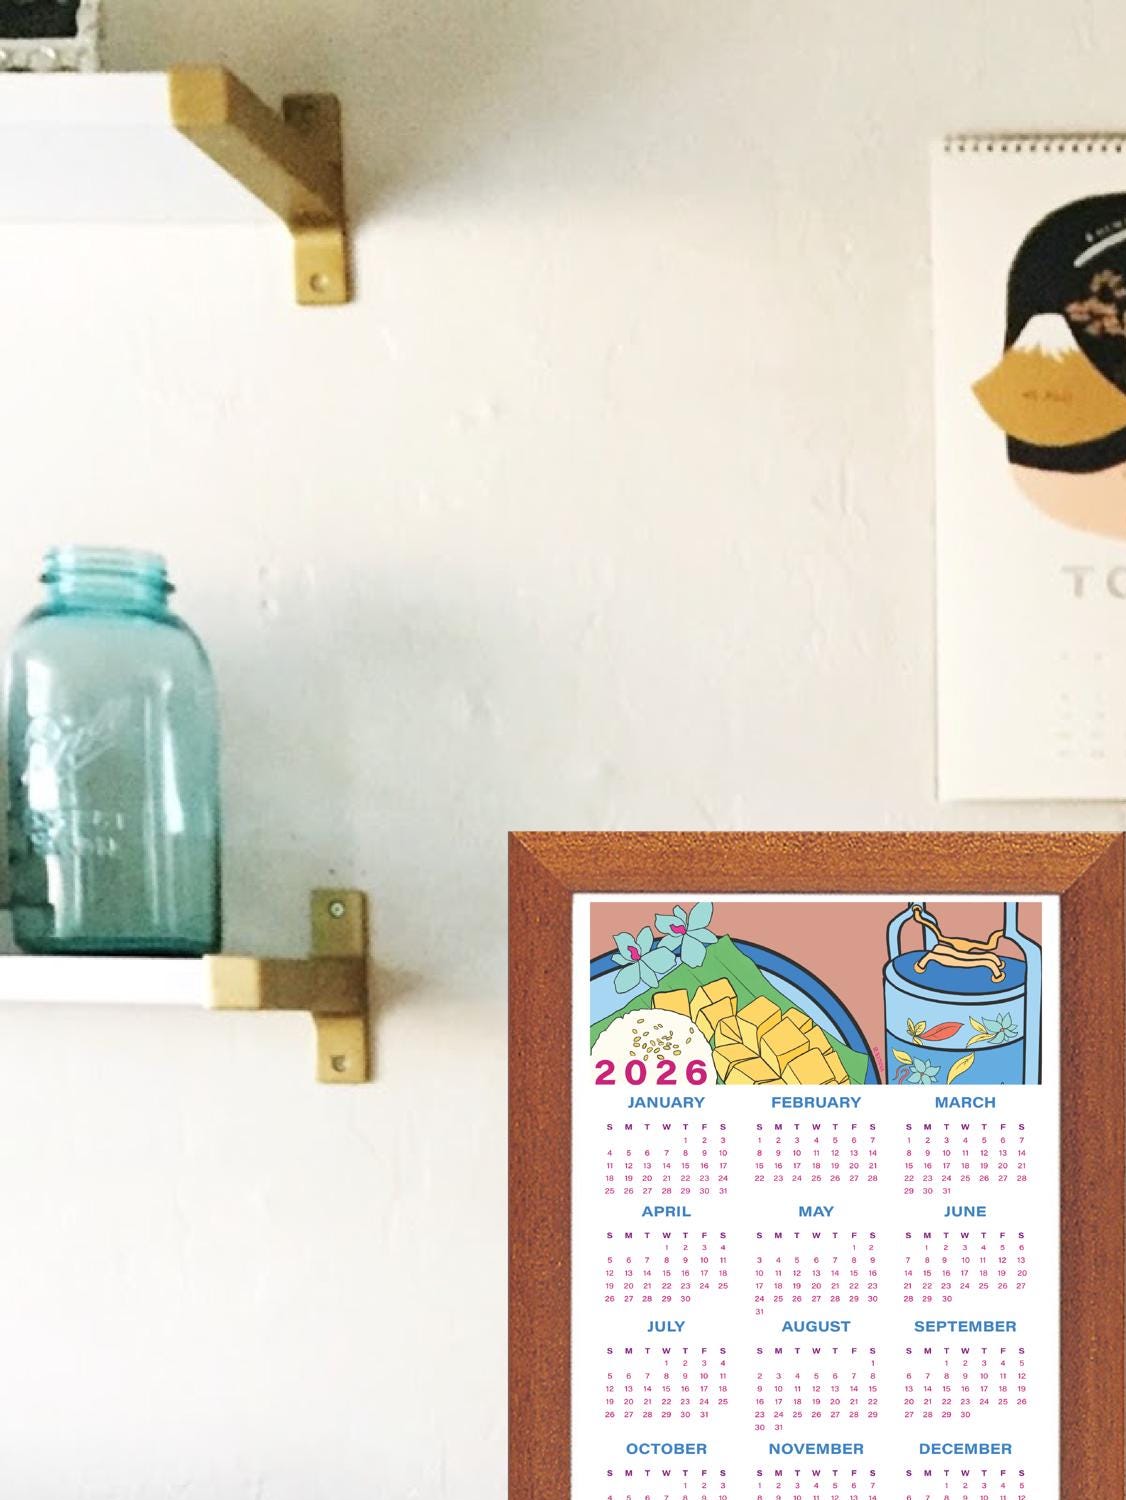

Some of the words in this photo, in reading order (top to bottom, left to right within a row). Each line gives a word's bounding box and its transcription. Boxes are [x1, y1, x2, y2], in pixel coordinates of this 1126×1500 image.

[595, 1059, 707, 1085] 2026
[627, 1096, 706, 1109] JANUARY
[771, 1096, 862, 1109] FEBRUARY
[935, 1096, 996, 1109] MARCH
[606, 1123, 613, 1131] S
[624, 1123, 633, 1131] M
[643, 1123, 651, 1131] T
[662, 1123, 672, 1131] W
[682, 1123, 689, 1131] T
[701, 1123, 708, 1131] F
[719, 1123, 727, 1131] S
[756, 1123, 763, 1131] S
[774, 1123, 783, 1131] M
[793, 1123, 800, 1131] T
[811, 1123, 821, 1131] W
[832, 1123, 839, 1131] T
[851, 1123, 857, 1131] F
[869, 1123, 876, 1131] S
[905, 1123, 913, 1131] S
[923, 1123, 932, 1131] M
[943, 1123, 950, 1131] T
[960, 1123, 970, 1131] W
[981, 1123, 988, 1131] T
[1000, 1123, 1007, 1131] F
[1018, 1123, 1025, 1131] S
[605, 1174, 614, 1182] 18
[624, 1174, 633, 1182] 19
[642, 1174, 653, 1182] 20
[662, 1174, 671, 1182] 21
[680, 1174, 691, 1182] 22
[699, 1174, 710, 1182] 23
[718, 1174, 728, 1182] 24
[754, 1174, 765, 1182] 22
[773, 1174, 784, 1182] 23
[792, 1174, 802, 1182] 24
[811, 1174, 822, 1182] 25
[830, 1174, 841, 1182] 26
[849, 1174, 859, 1182] 27
[867, 1174, 878, 1182] 28
[904, 1174, 915, 1182] 22
[922, 1174, 933, 1182] 23
[941, 1174, 952, 1182] 24
[960, 1174, 971, 1182] 25
[979, 1174, 990, 1182] 26
[998, 1174, 1008, 1182] 27
[1016, 1174, 1028, 1182] 28
[641, 1205, 692, 1218] APRIL
[798, 1205, 835, 1218] MAY
[943, 1205, 987, 1218] JUNE
[605, 1269, 614, 1277] 12
[624, 1269, 633, 1277] 13
[643, 1269, 652, 1277] 14
[662, 1269, 672, 1277] 15
[681, 1269, 690, 1277] 16
[700, 1269, 709, 1277] 17
[719, 1269, 728, 1277] 18
[755, 1269, 764, 1277] 10
[775, 1269, 782, 1277] 11
[793, 1269, 802, 1277] 12
[812, 1269, 821, 1277] 13
[831, 1269, 840, 1277] 14
[850, 1269, 859, 1277] 15
[868, 1269, 878, 1277] 16
[904, 1269, 913, 1277] 14
[923, 1269, 932, 1277] 15
[942, 1269, 951, 1277] 16
[960, 1269, 969, 1277] 17
[979, 1269, 988, 1277] 18
[997, 1269, 1007, 1277] 19
[1017, 1269, 1028, 1277] 20
[647, 1320, 686, 1333] JULY
[781, 1320, 852, 1333] AUGUST
[914, 1320, 1017, 1333] SEPTEMBER
[606, 1398, 615, 1406] 19
[623, 1398, 634, 1406] 20
[643, 1398, 652, 1406] 21
[661, 1398, 672, 1406] 22
[680, 1398, 690, 1406] 23
[699, 1398, 710, 1406] 24
[717, 1398, 729, 1406] 25
[903, 1398, 915, 1406] 20
[923, 1398, 932, 1406] 21
[941, 1398, 952, 1406] 22
[960, 1398, 971, 1406] 23
[979, 1398, 990, 1406] 24
[998, 1398, 1009, 1406] 25
[1016, 1398, 1027, 1406] 26
[754, 1410, 765, 1419] 23
[773, 1410, 784, 1419] 24
[792, 1410, 803, 1419] 25
[811, 1410, 822, 1419] 26
[830, 1410, 841, 1419] 27
[848, 1410, 859, 1419] 28
[867, 1410, 878, 1419] 29
[625, 1442, 708, 1455] OCTOBER
[768, 1442, 864, 1455] NOVEMBER
[919, 1442, 1013, 1455] DECEMBER
[606, 1469, 614, 1477] S
[624, 1469, 633, 1477] M
[644, 1469, 651, 1477] T
[661, 1469, 672, 1477] W
[682, 1469, 689, 1477] T
[701, 1469, 708, 1477] F
[719, 1469, 727, 1477] S
[756, 1469, 763, 1477] S
[774, 1469, 783, 1477] M
[794, 1469, 801, 1477] T
[811, 1469, 821, 1477] W
[831, 1469, 839, 1477] T
[851, 1469, 857, 1477] F
[869, 1469, 876, 1477] S
[905, 1469, 913, 1477] S
[923, 1469, 932, 1477] M
[943, 1469, 950, 1477] T
[960, 1469, 970, 1477] W
[981, 1469, 988, 1477] T
[1000, 1469, 1007, 1477] F
[1018, 1469, 1025, 1477] S
